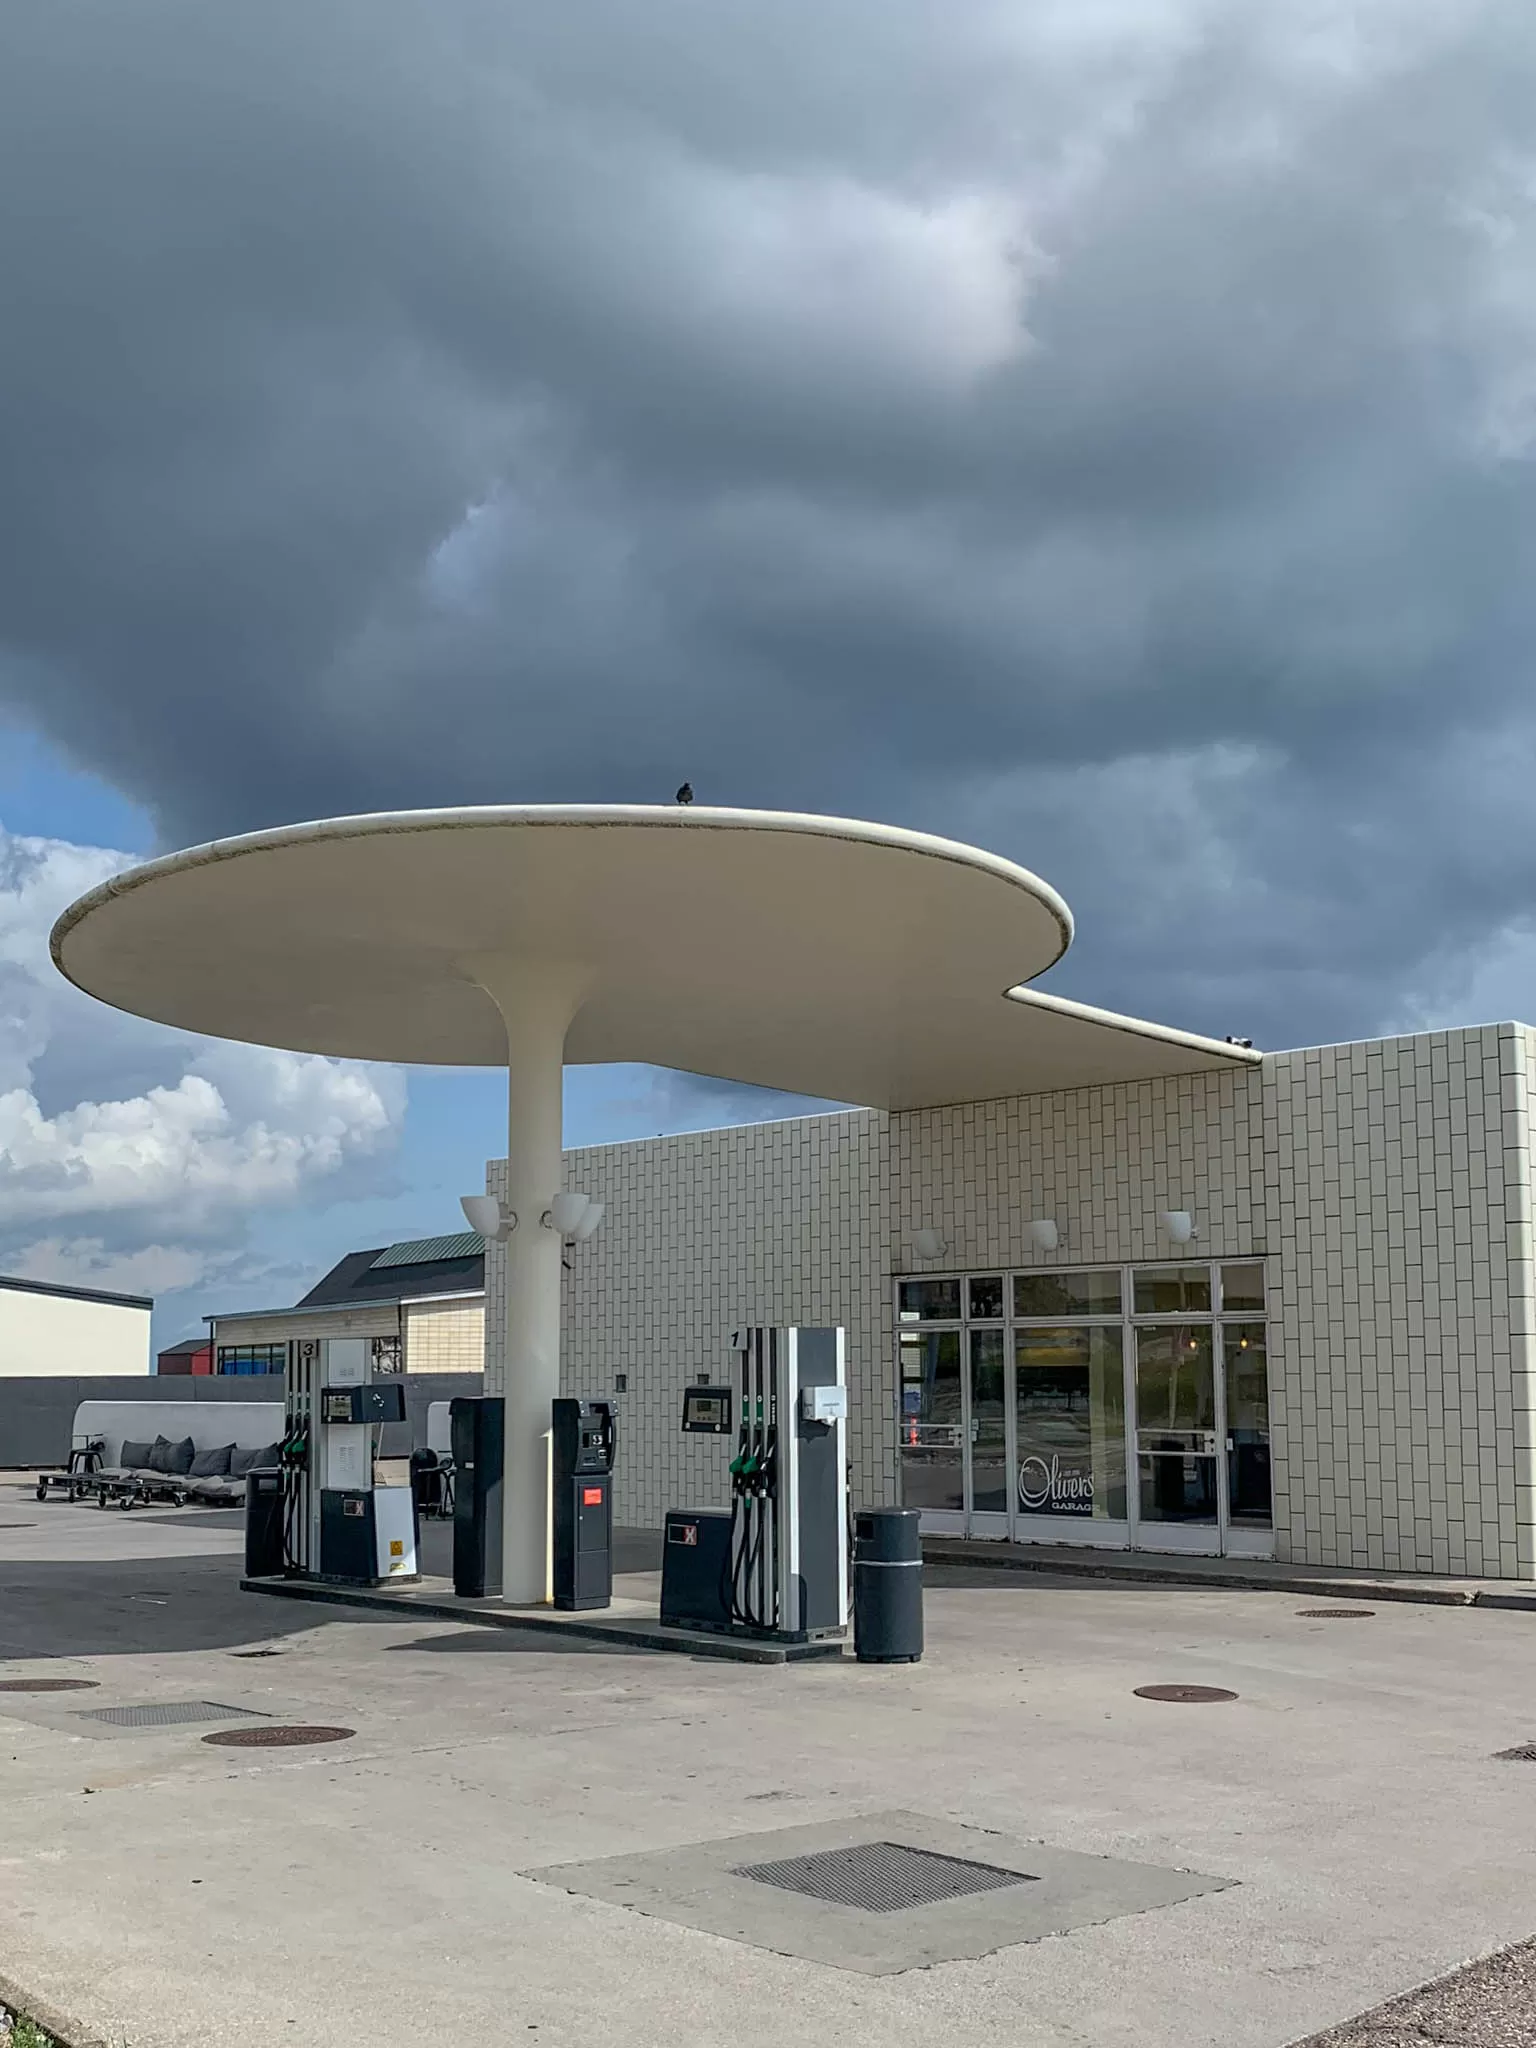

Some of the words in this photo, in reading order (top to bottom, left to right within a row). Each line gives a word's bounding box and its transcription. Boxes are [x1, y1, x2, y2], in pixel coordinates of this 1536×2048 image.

[731, 1331, 739, 1348] 1
[303, 1343, 314, 1356] 3
[1051, 1502, 1100, 1512] GARAGE
